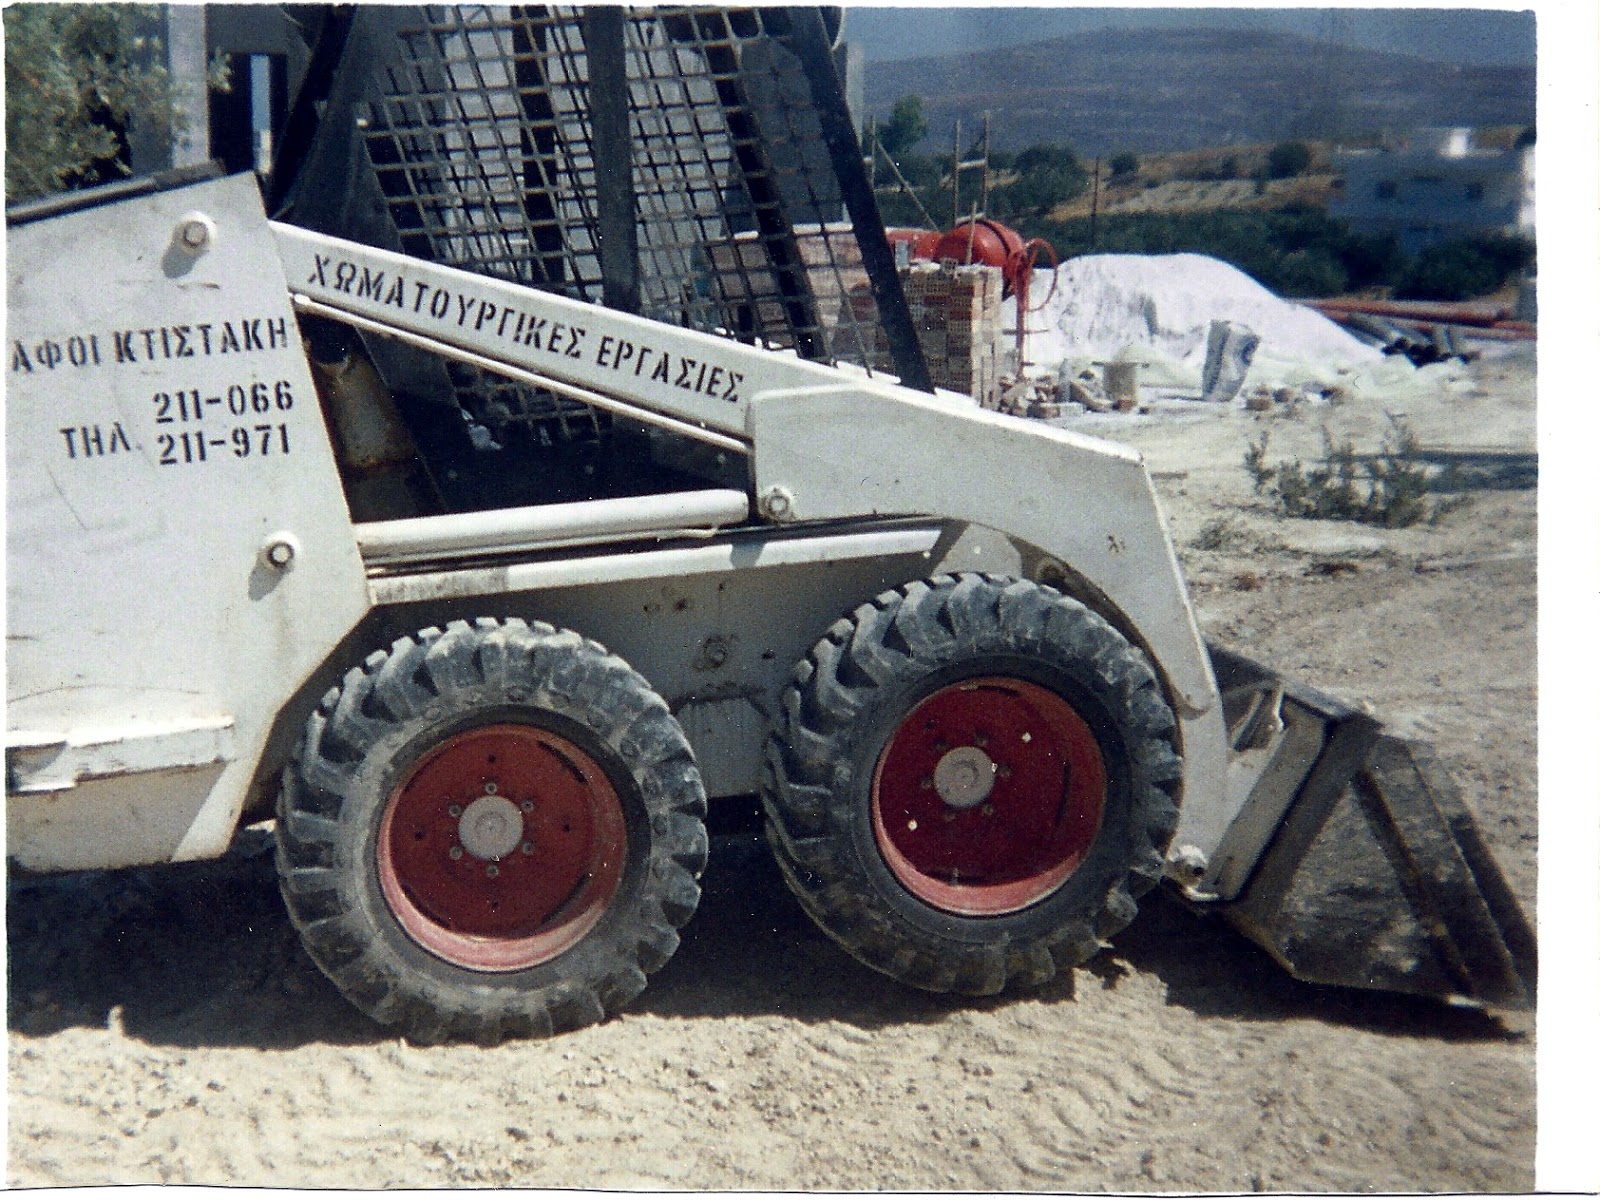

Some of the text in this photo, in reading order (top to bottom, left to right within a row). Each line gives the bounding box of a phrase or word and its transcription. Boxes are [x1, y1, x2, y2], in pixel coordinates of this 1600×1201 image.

[12, 317, 288, 372] ΑΦΟΙ ΚΤΙΣΤΑΚΗ
[308, 253, 744, 402] ΧΩΜΑΤΟΥΡΓΙΚΕΣ ΕΡΓΑΣΙΕΣ
[153, 380, 293, 423] 211-066
[157, 423, 290, 465] 211-971
